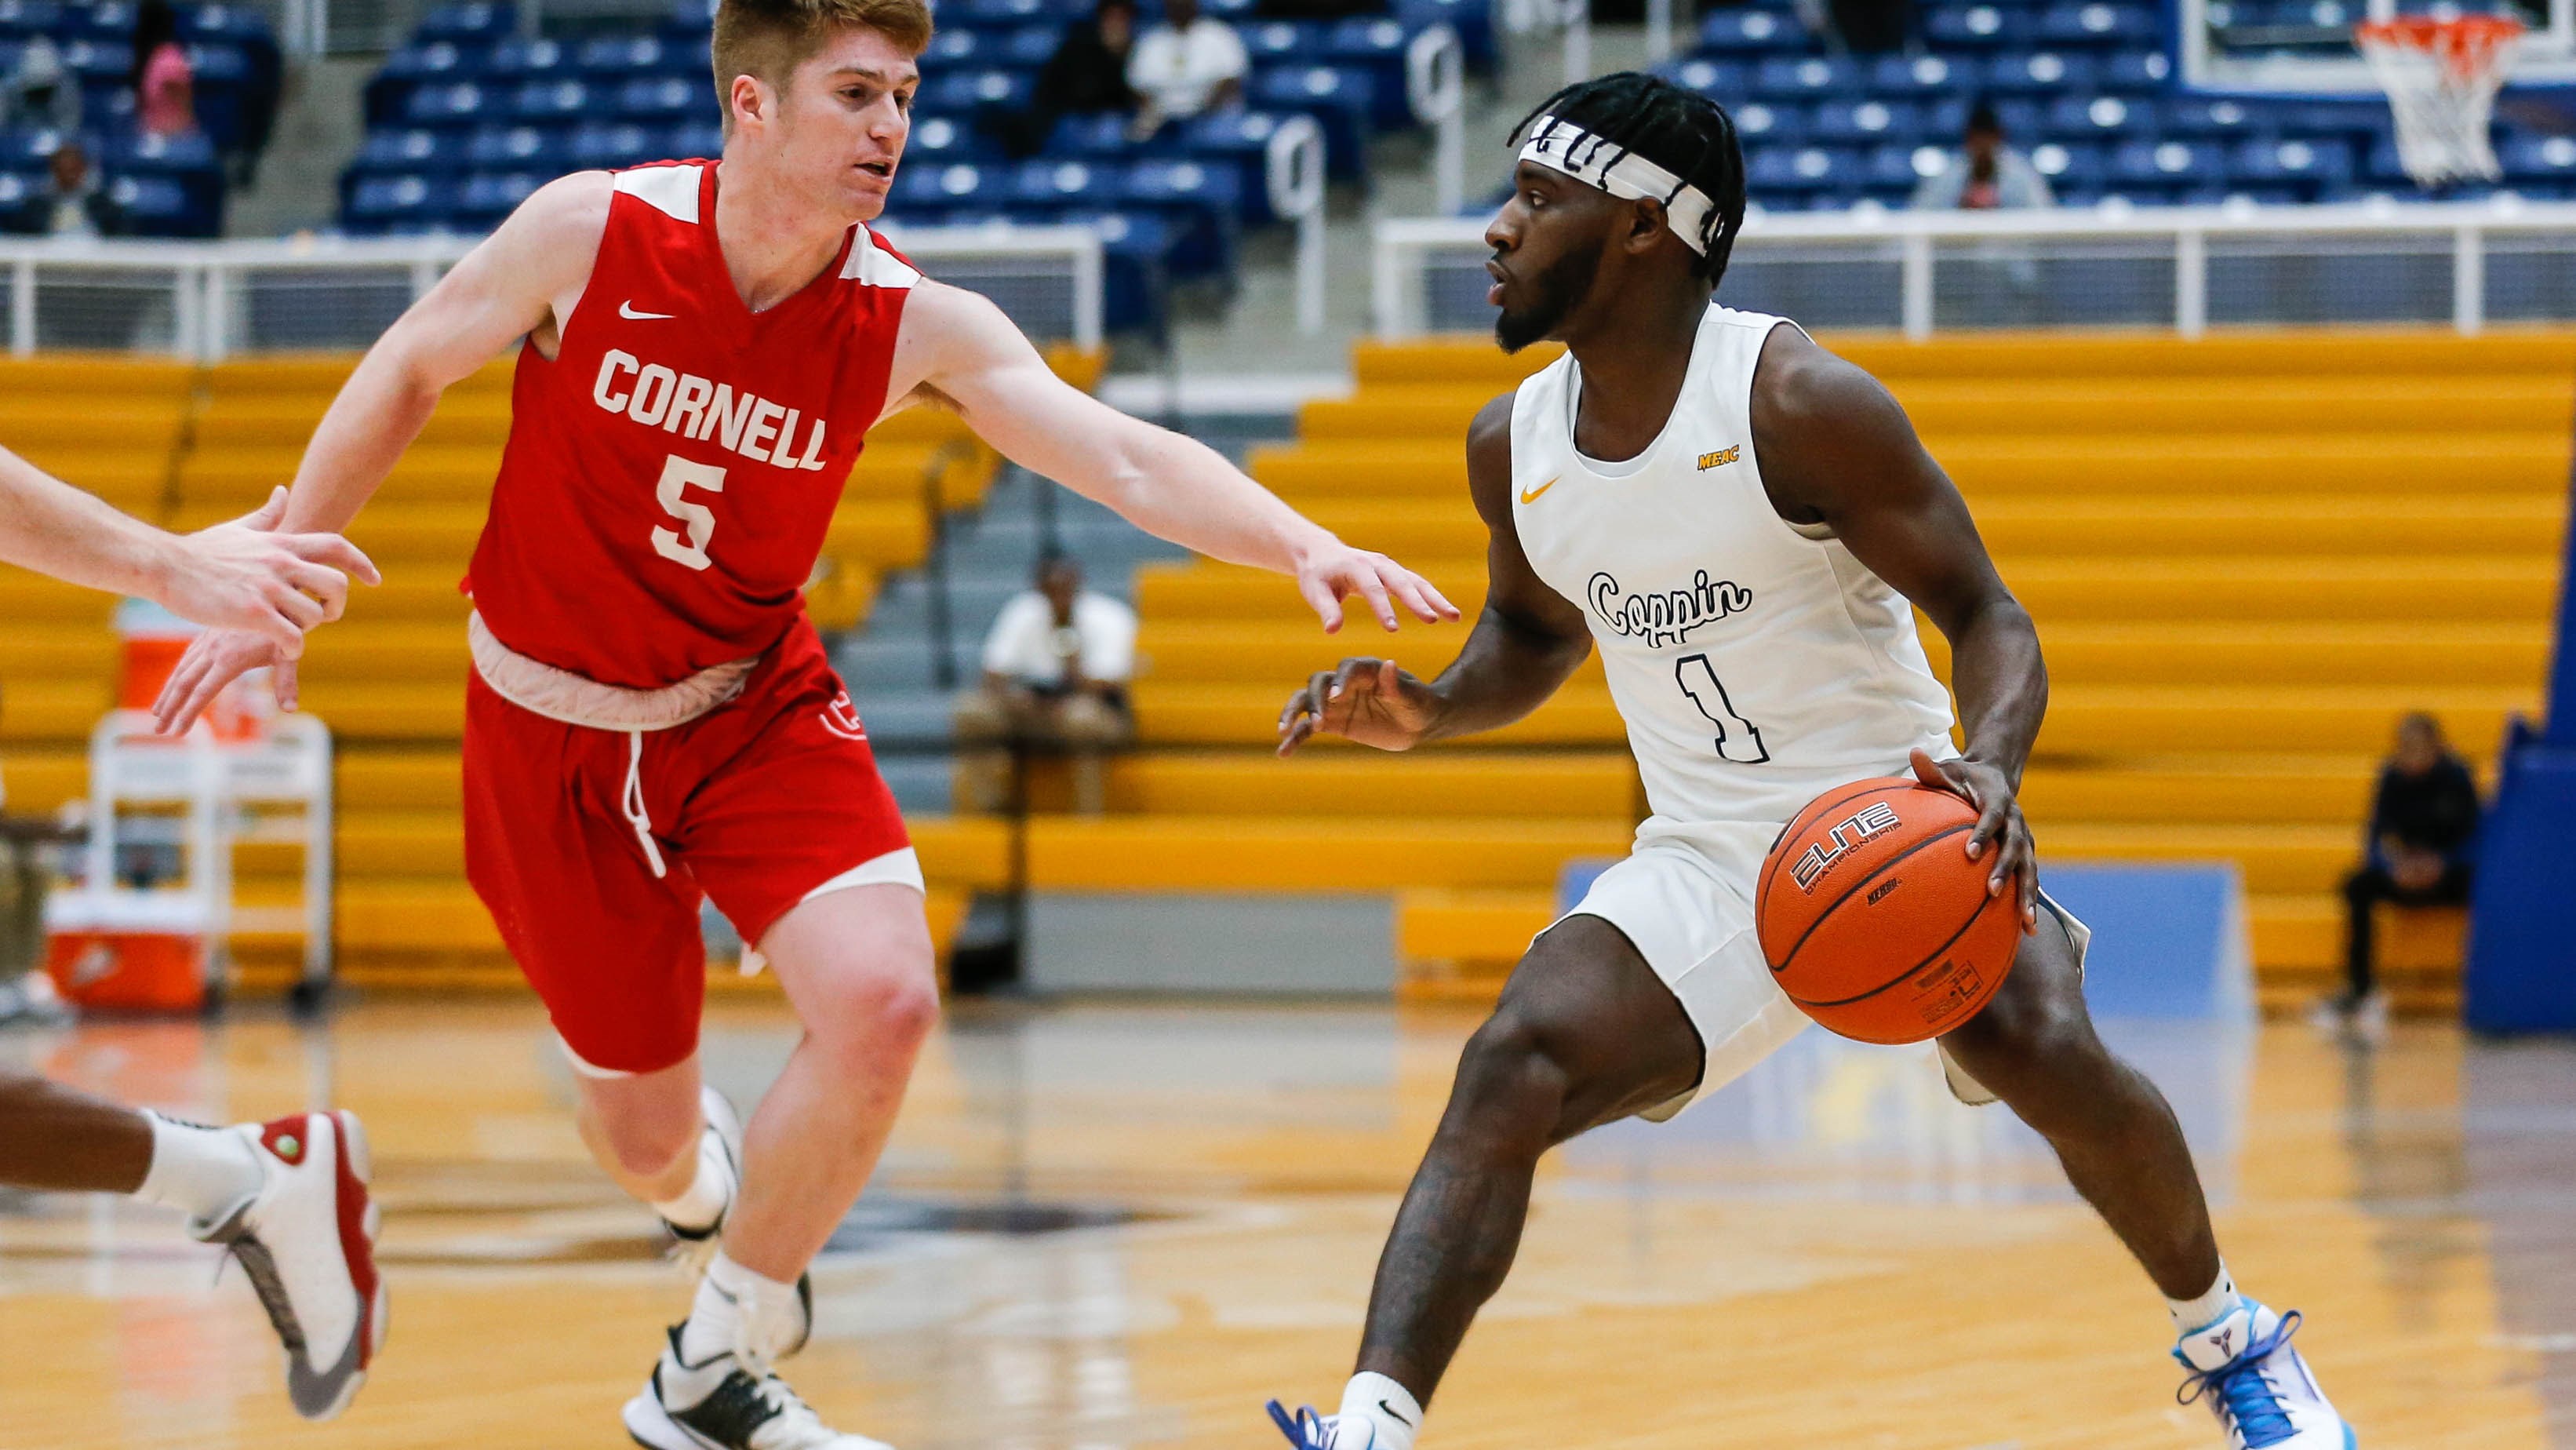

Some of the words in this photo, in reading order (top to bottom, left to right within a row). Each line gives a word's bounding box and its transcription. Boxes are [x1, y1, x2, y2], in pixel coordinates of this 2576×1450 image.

[593, 348, 827, 472] CORNELL
[1697, 443, 1740, 472] MEAC
[650, 453, 727, 572] 5
[1587, 569, 1752, 649] Coppin
[1675, 653, 1770, 764] 1
[1789, 800, 1900, 891] ELITE
[1804, 822, 1903, 896] CHAMPIONSHIP
